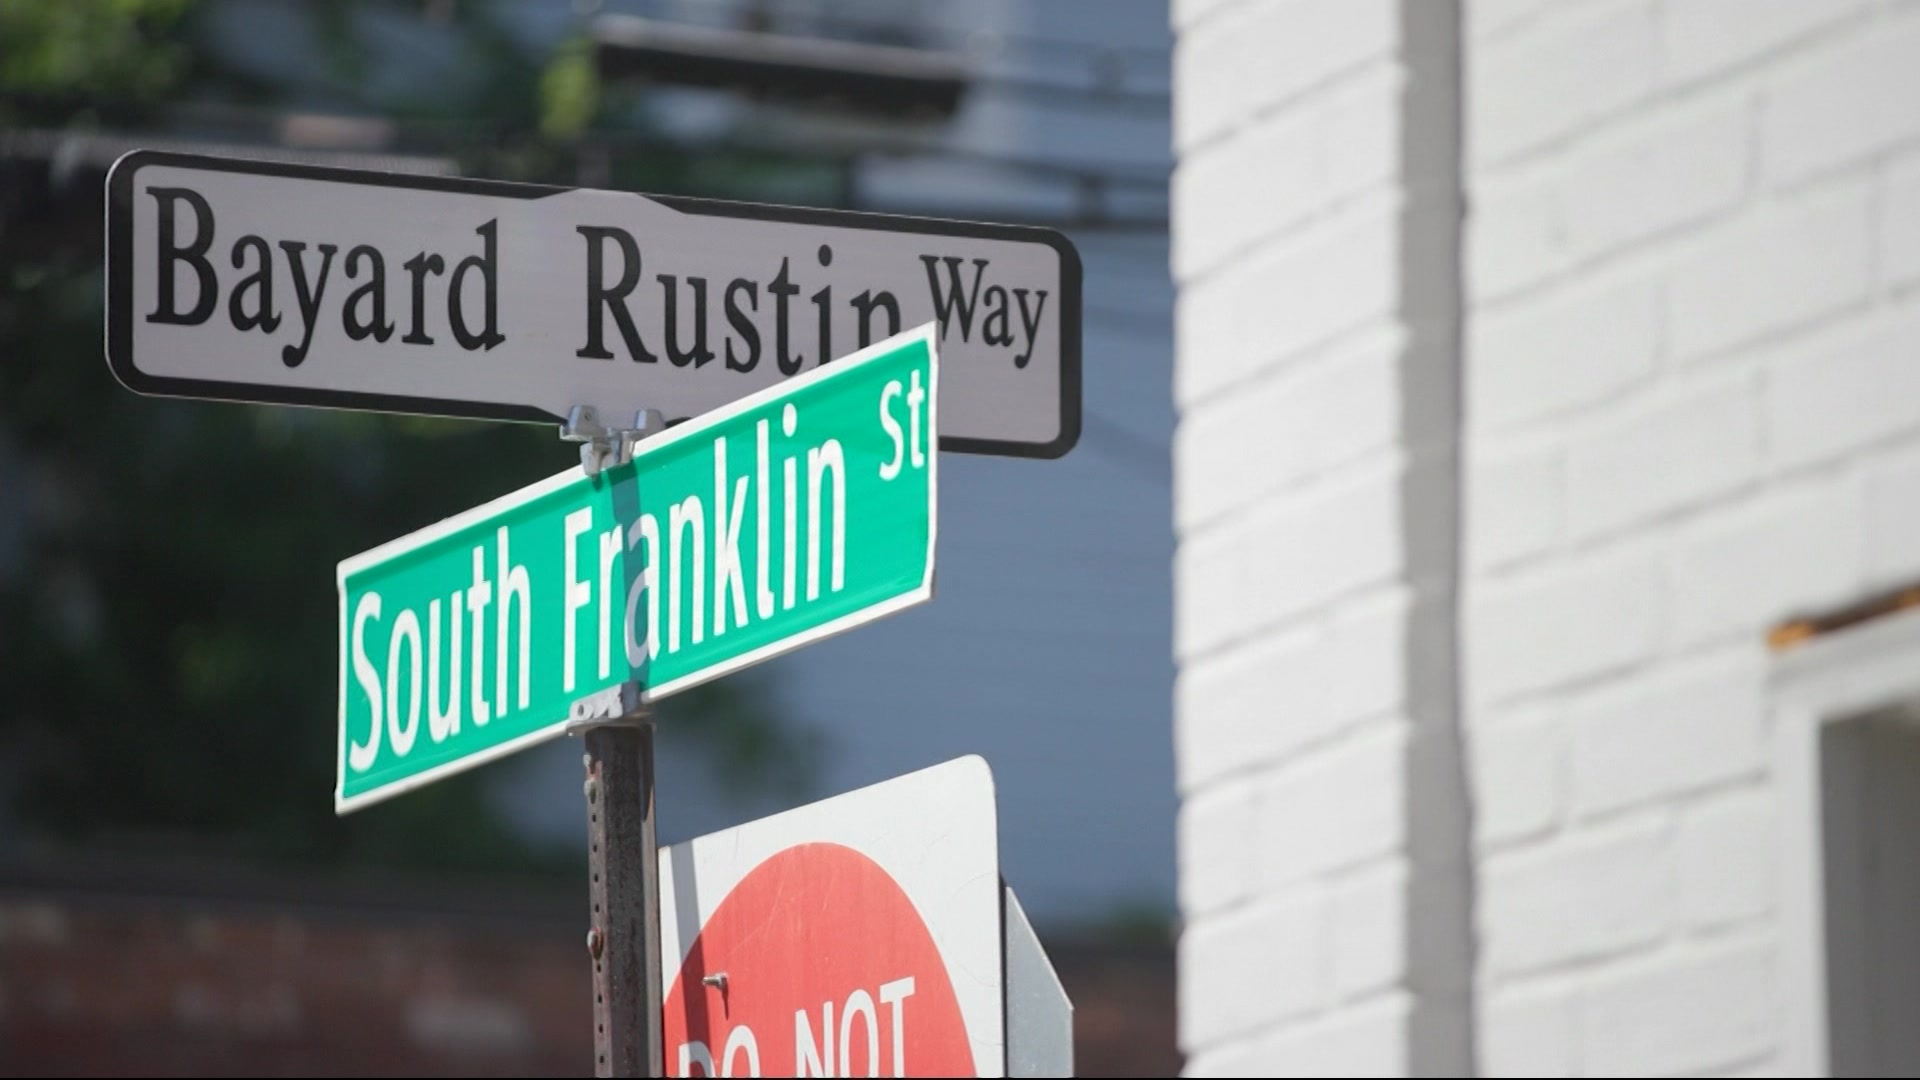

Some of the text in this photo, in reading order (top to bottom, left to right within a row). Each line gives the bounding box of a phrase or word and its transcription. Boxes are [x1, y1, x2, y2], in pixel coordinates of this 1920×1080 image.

[146, 186, 1048, 376] Bayard Rustin Way
[349, 369, 925, 771] South Franklin St
[796, 976, 915, 1078] NOT
